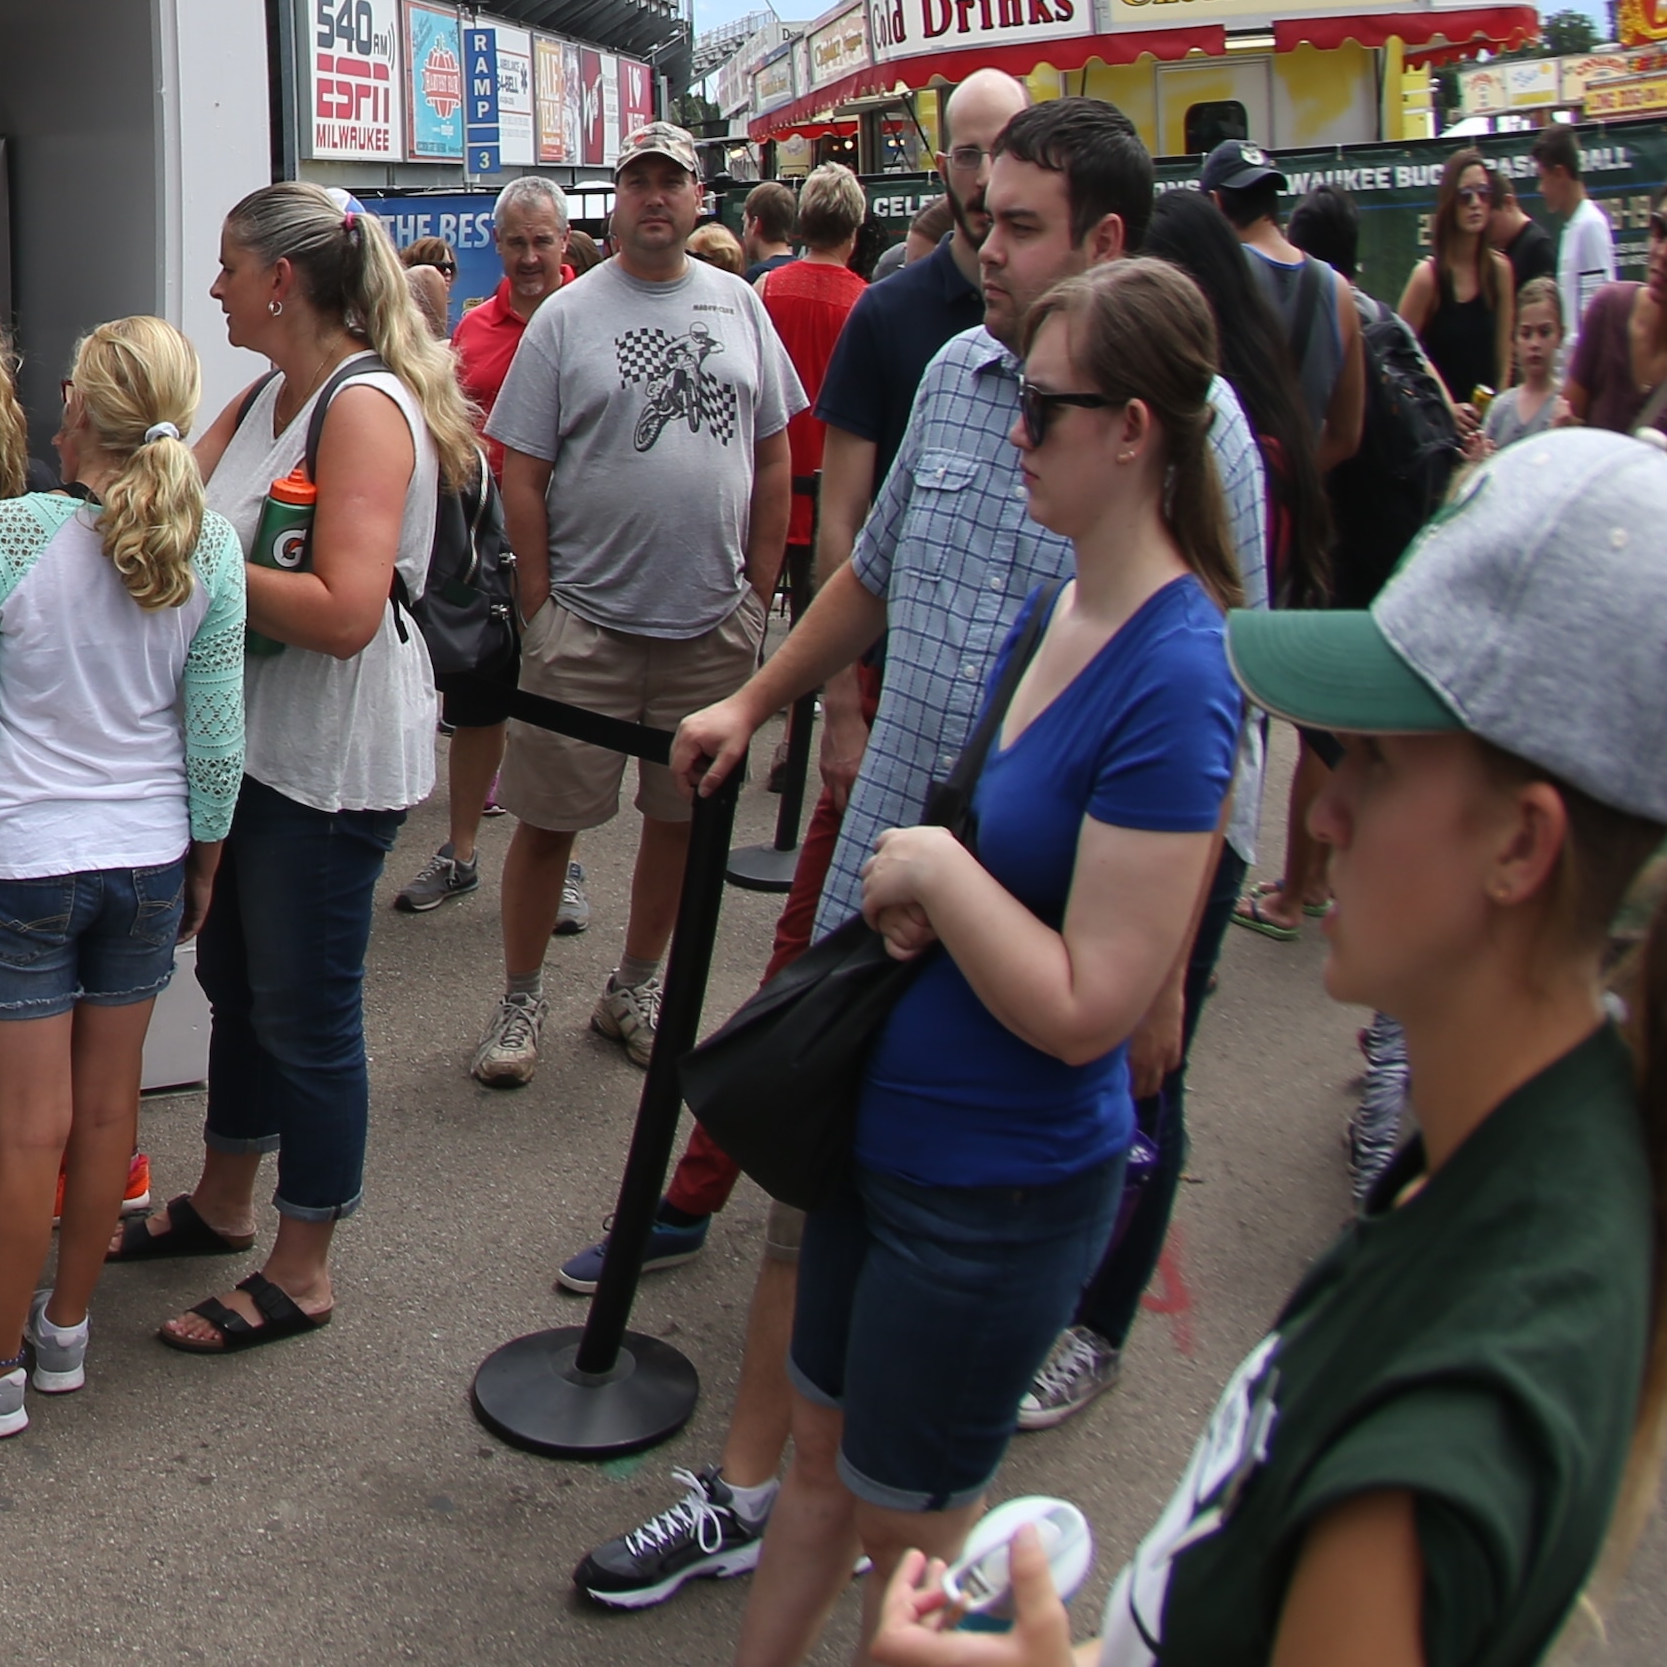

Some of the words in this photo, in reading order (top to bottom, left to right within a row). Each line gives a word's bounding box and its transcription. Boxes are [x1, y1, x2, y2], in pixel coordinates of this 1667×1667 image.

[373, 33, 388, 56] AM
[316, 53, 390, 124] ESPN
[473, 34, 492, 119] RAMP
[316, 123, 390, 152] MILWAUKEE
[478, 151, 491, 169] 3
[378, 213, 431, 249] THE
[439, 212, 496, 249] BES
